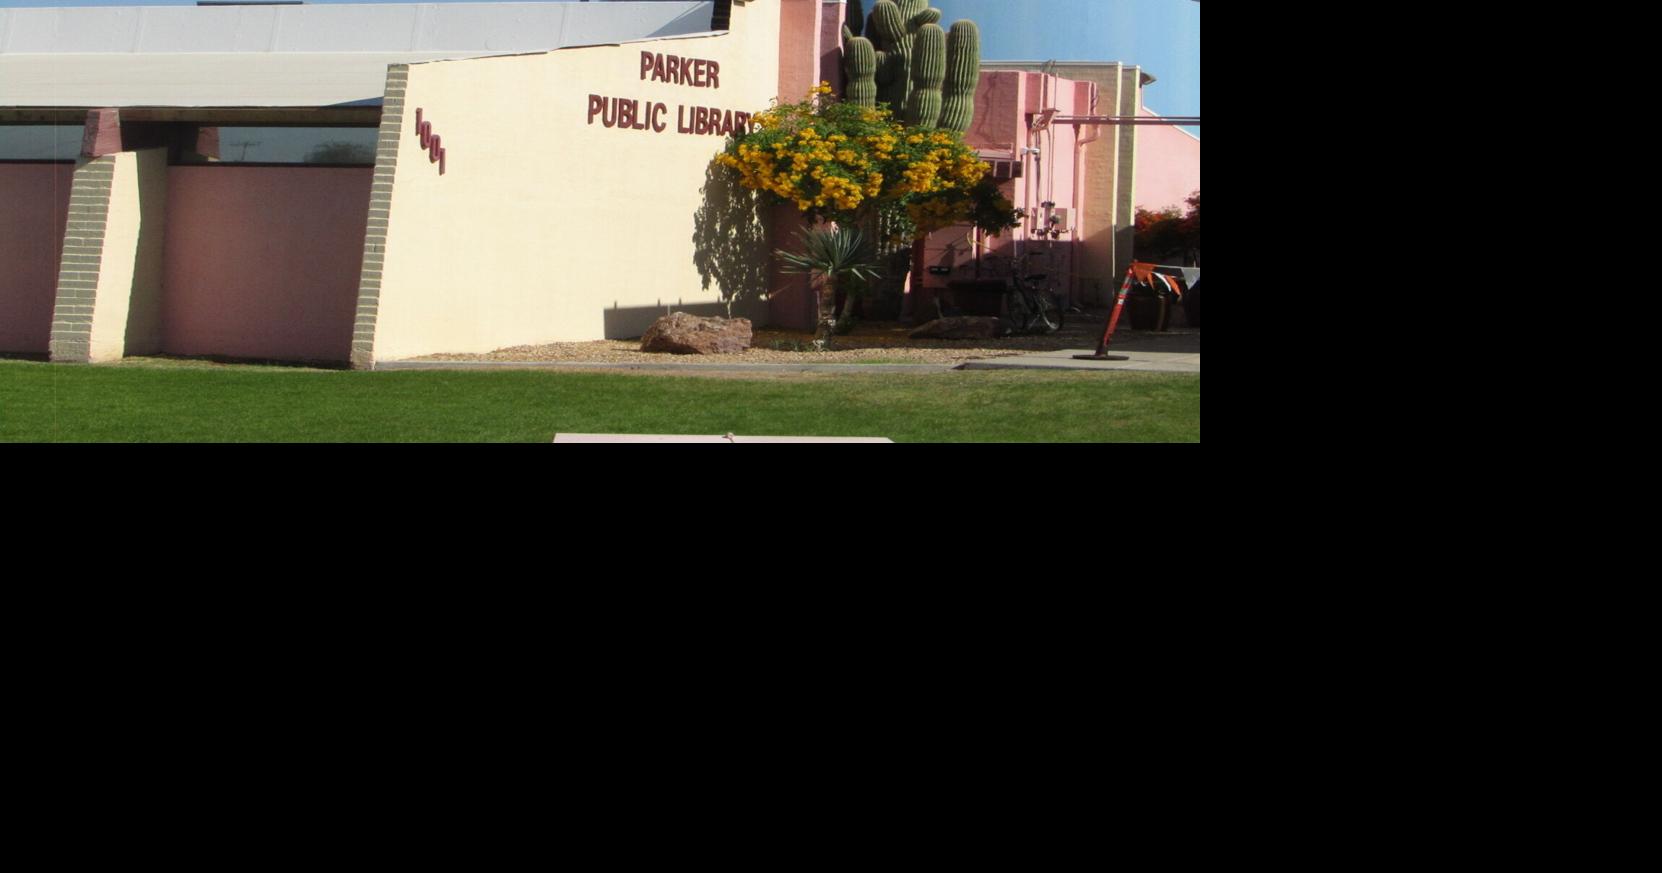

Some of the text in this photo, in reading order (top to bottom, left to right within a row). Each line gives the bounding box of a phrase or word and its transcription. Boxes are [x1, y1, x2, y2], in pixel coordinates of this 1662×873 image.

[640, 51, 720, 89] PARKER
[588, 94, 667, 133] PUBLIC
[415, 107, 446, 175] 1001
